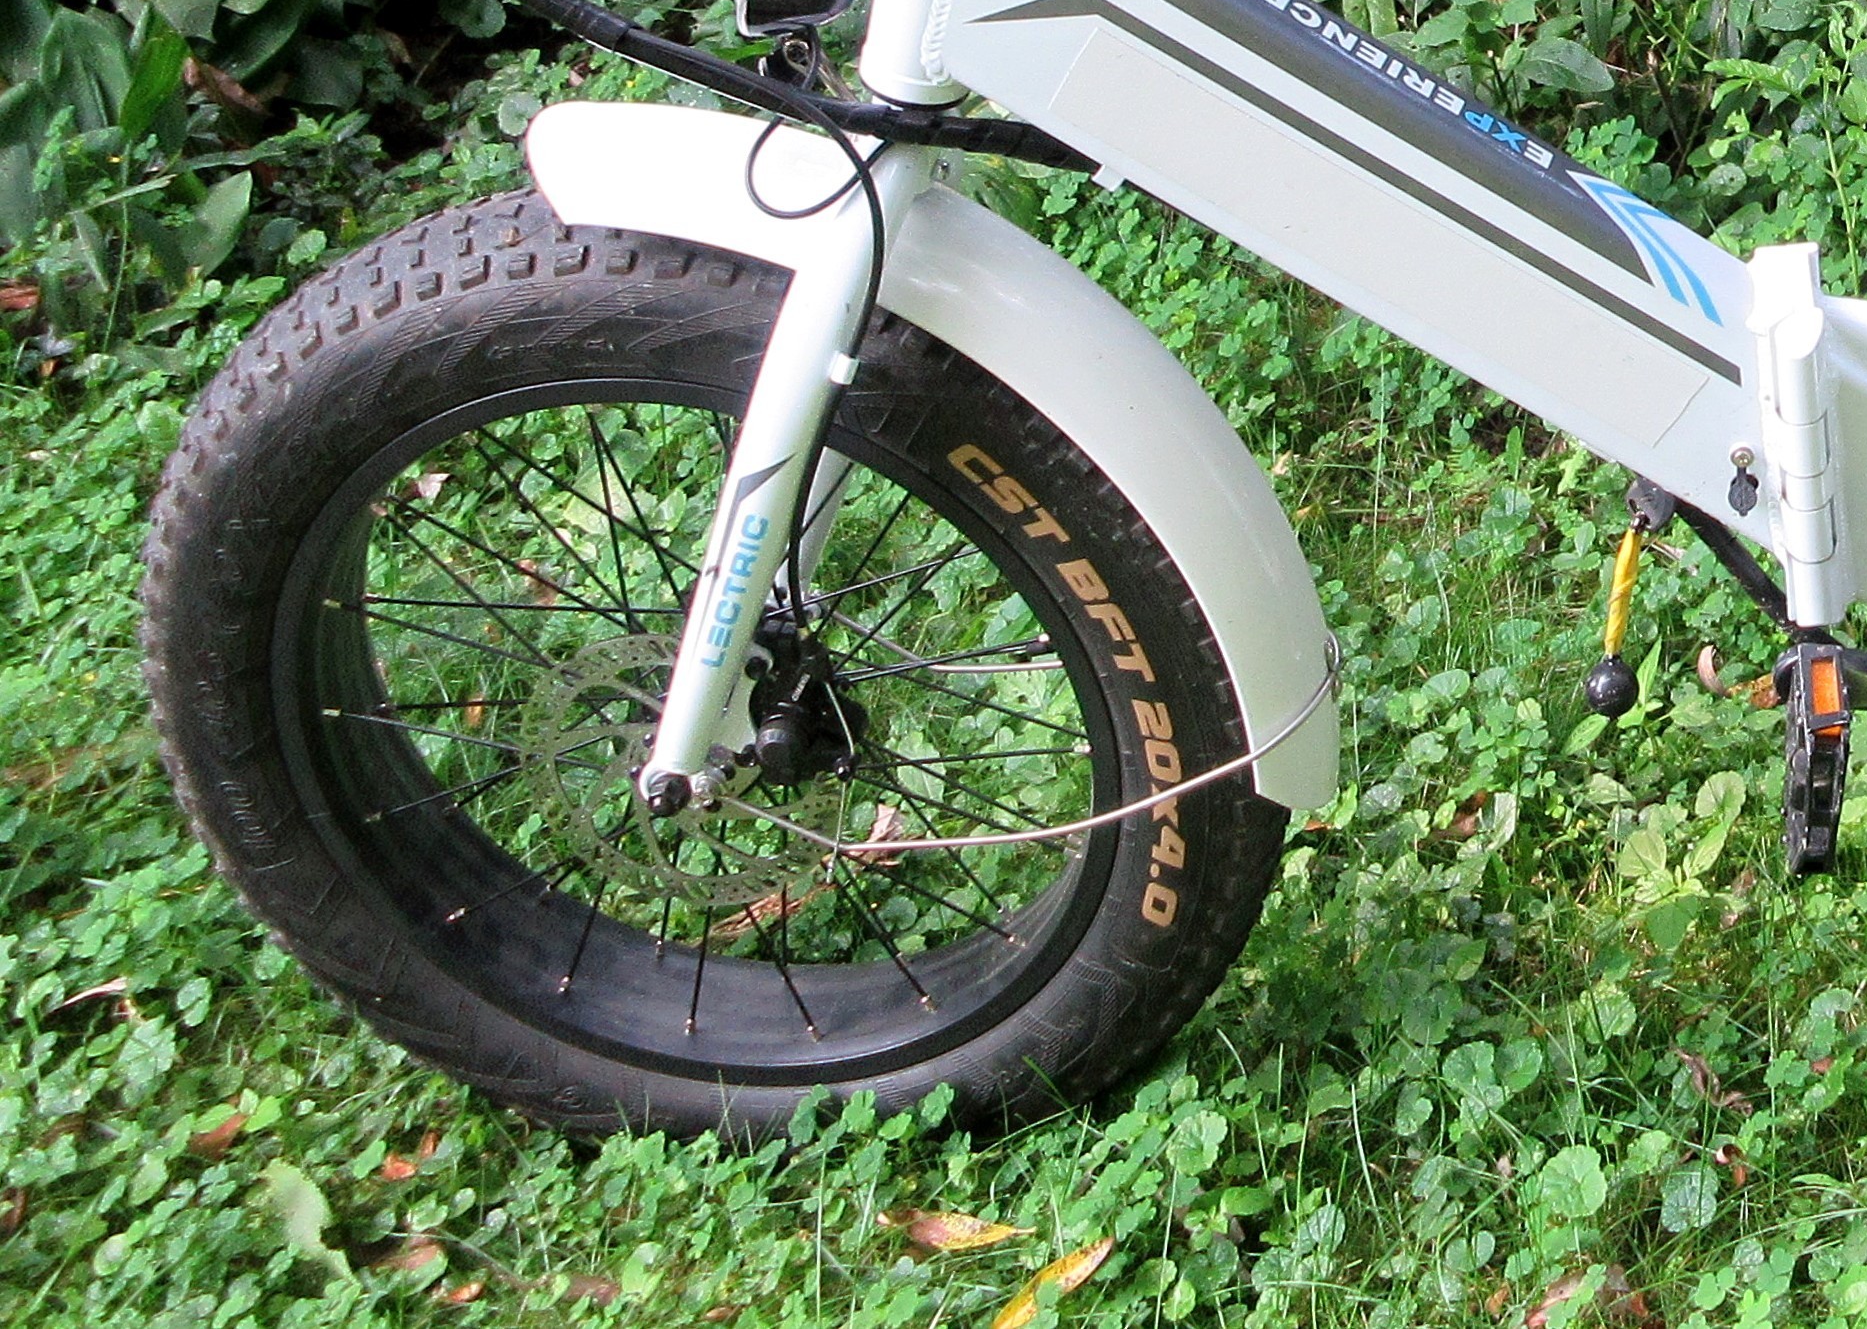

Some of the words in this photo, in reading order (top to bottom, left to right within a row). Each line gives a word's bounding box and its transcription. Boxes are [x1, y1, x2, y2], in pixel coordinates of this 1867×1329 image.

[701, 514, 769, 667] LECTRIC
[947, 443, 1071, 543] CST
[1056, 558, 1157, 683] BFT
